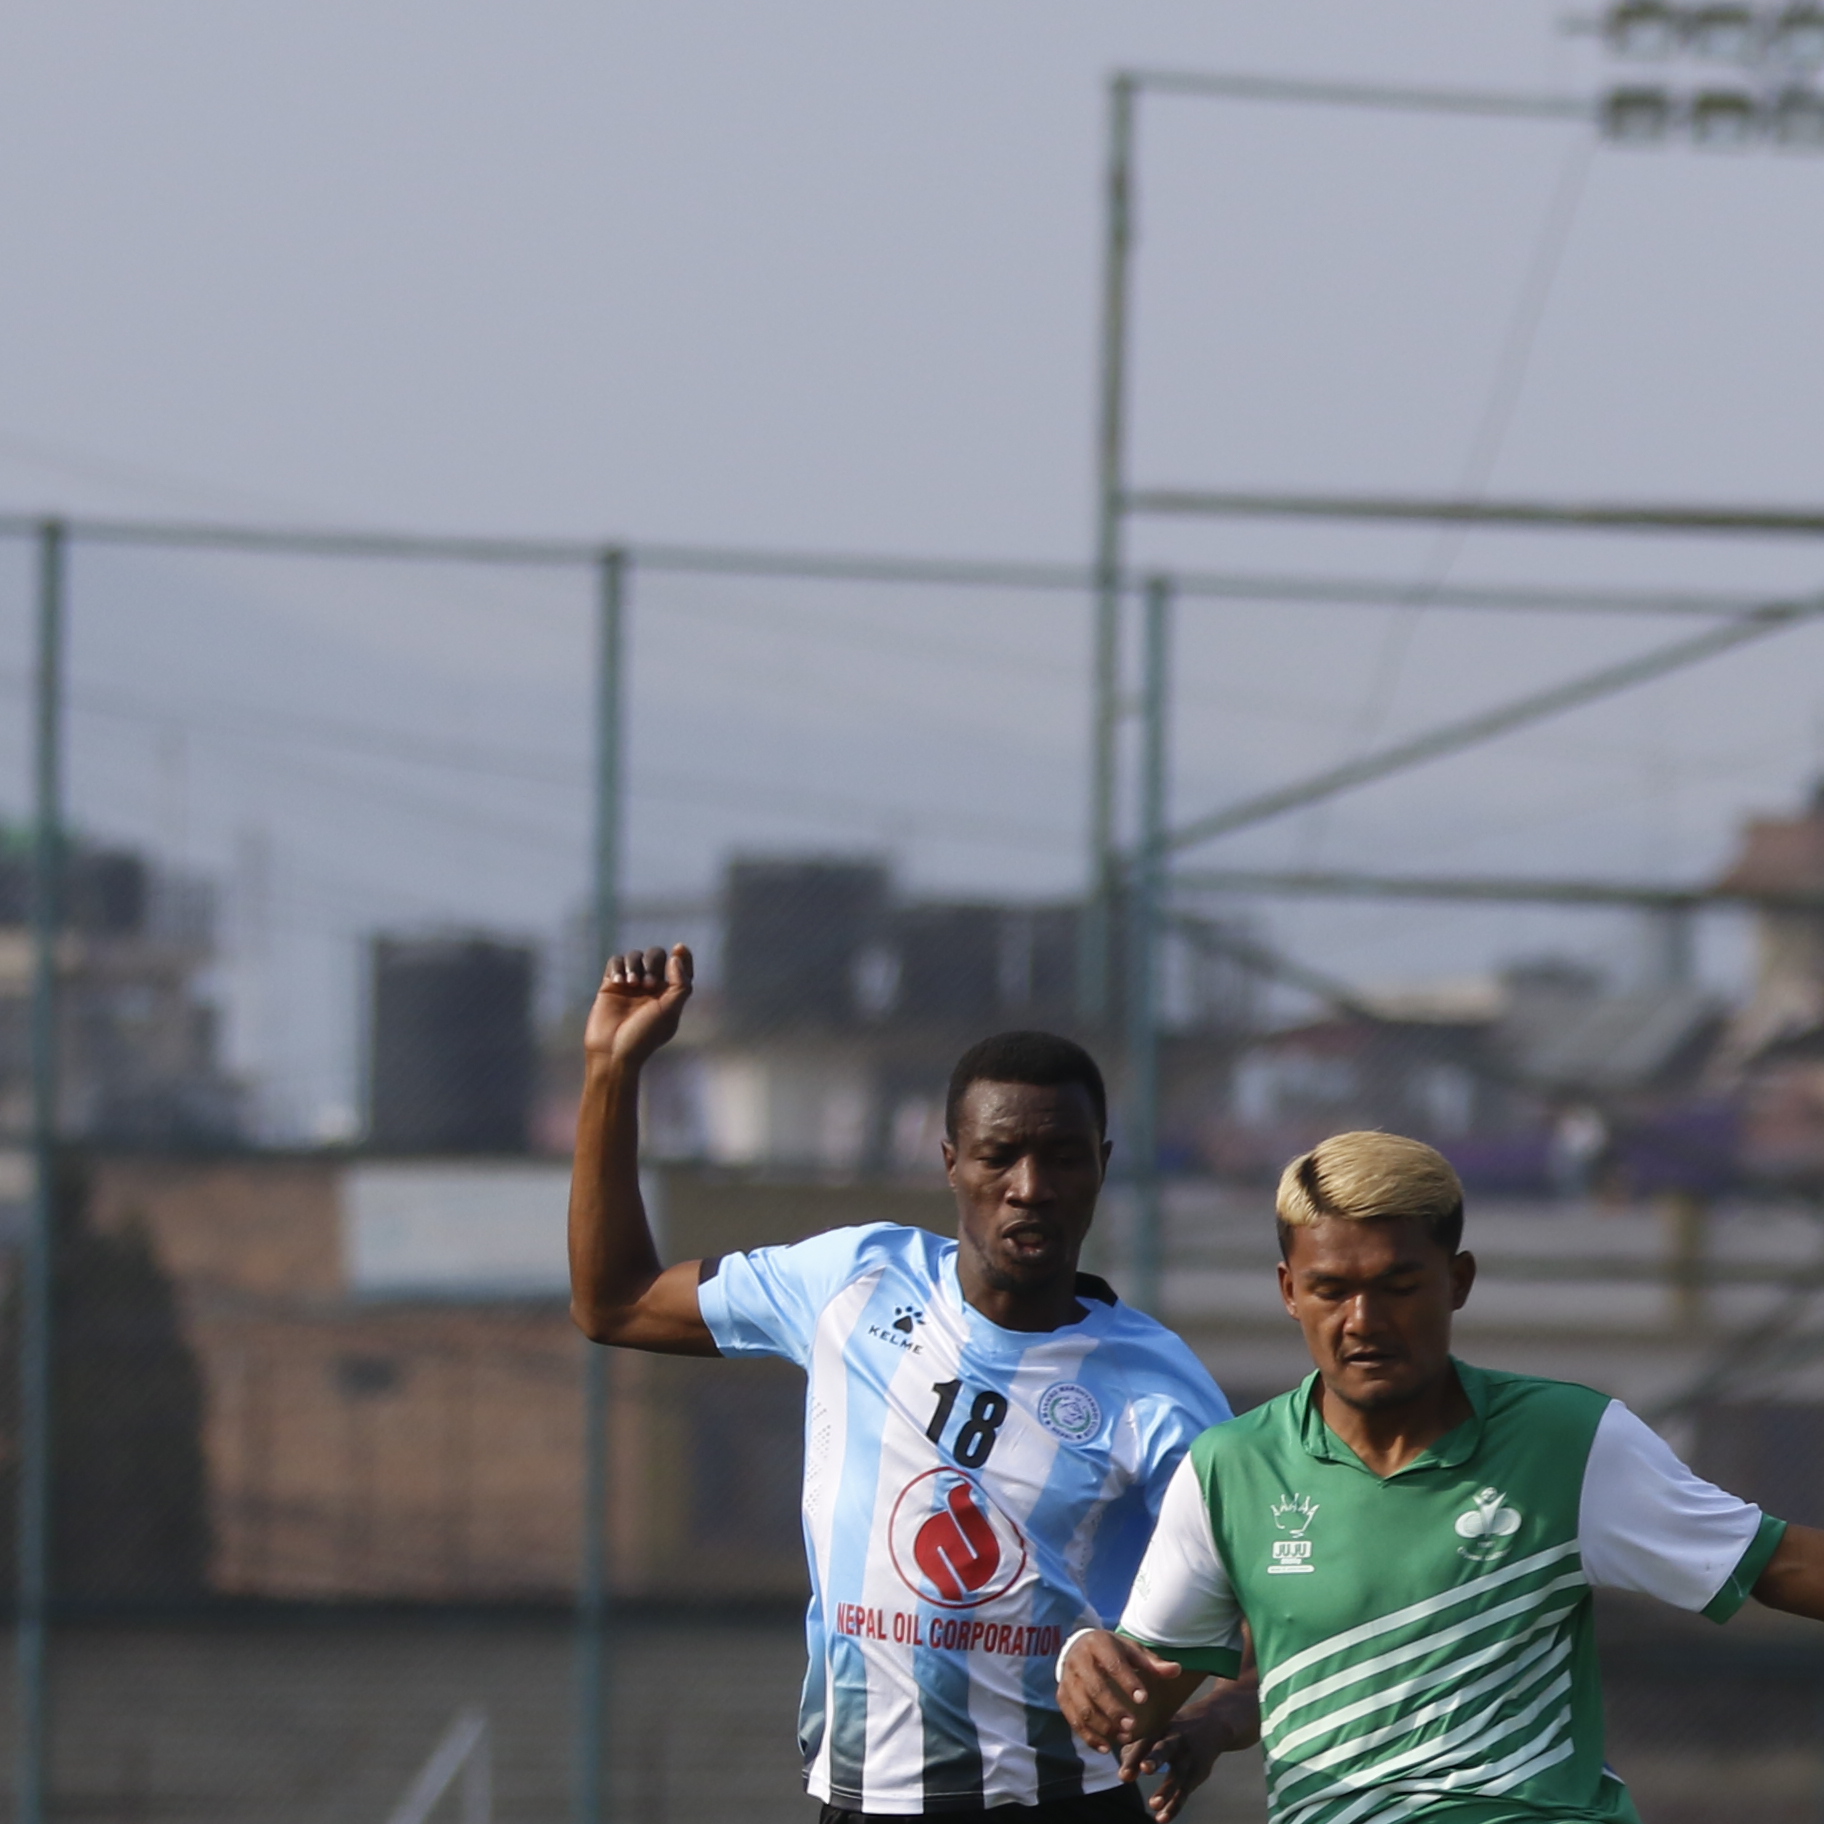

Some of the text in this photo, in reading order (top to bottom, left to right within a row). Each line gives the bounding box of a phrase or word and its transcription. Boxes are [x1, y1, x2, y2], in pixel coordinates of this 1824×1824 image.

[868, 1325, 923, 1355] KELME
[926, 1378, 1008, 1469] 18
[837, 1602, 1062, 1657] NEPAL OIL CORPORATION
